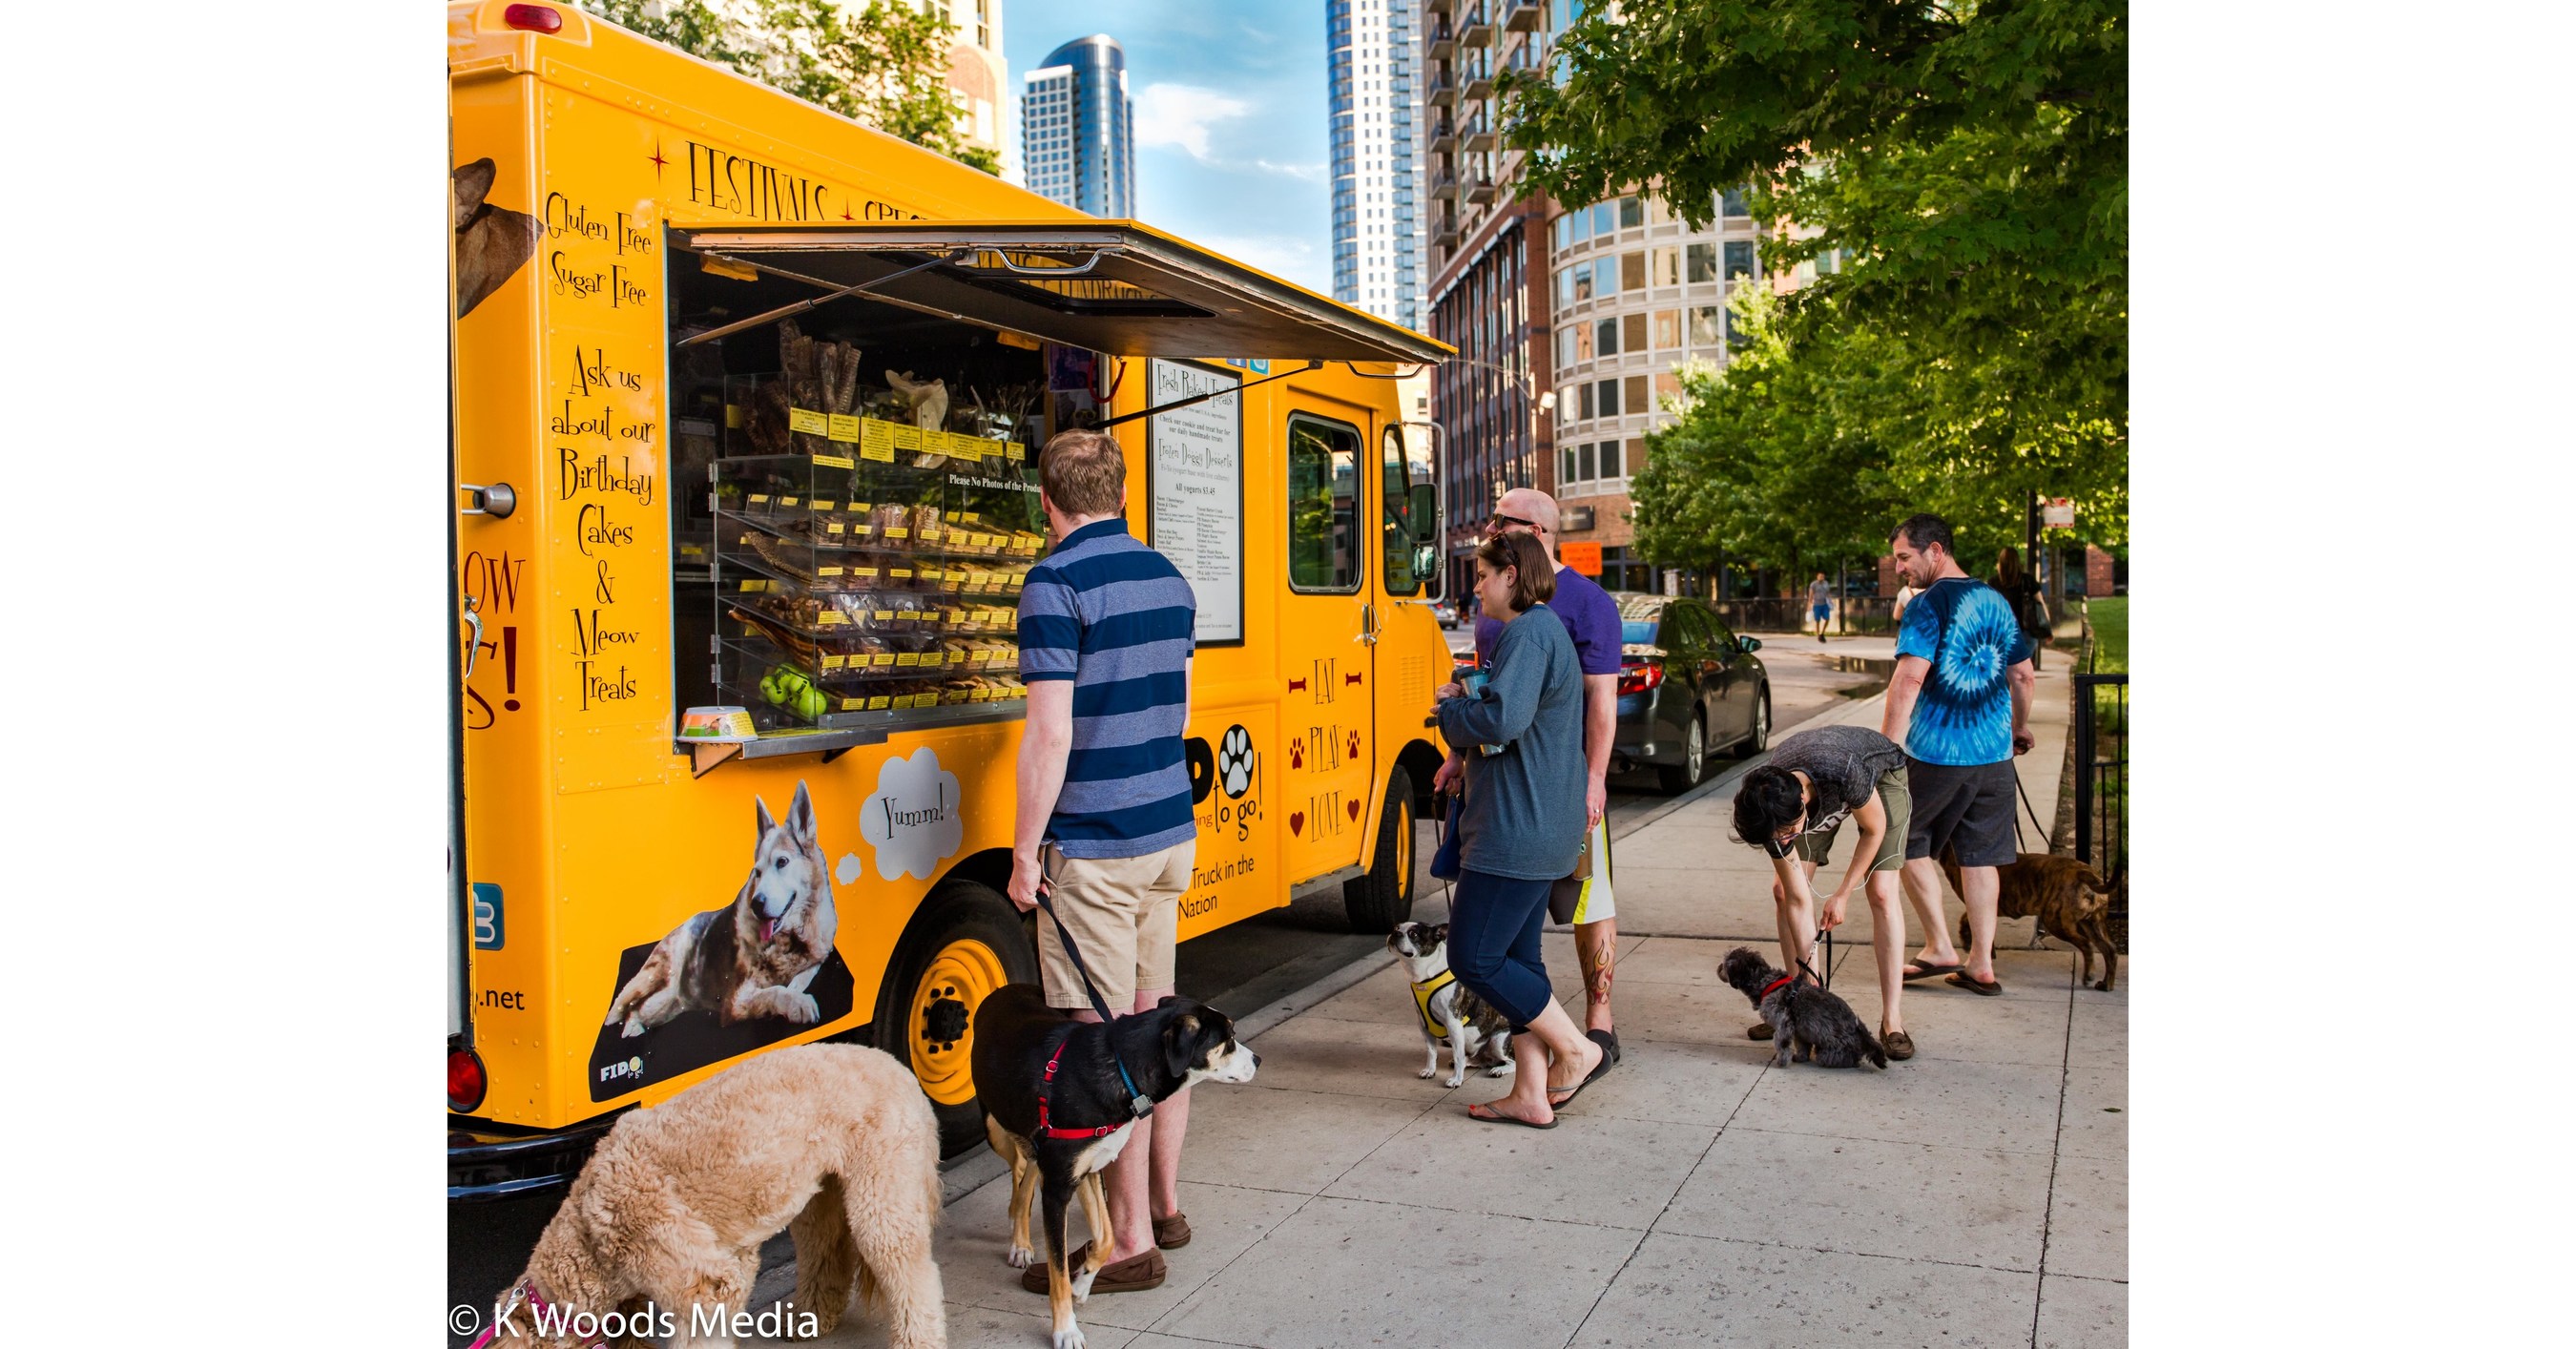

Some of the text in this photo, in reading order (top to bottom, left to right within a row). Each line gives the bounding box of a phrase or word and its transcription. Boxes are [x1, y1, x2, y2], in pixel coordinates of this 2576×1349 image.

[546, 192, 652, 256] Gluten Free
[551, 250, 646, 309] Sugar Free
[568, 344, 641, 397] Ask us
[551, 400, 655, 443] about our
[556, 447, 652, 506] Birthday
[949, 473, 970, 487] Please
[971, 476, 981, 488] No
[982, 478, 1004, 489] Photos
[1005, 480, 1012, 489] of
[1012, 481, 1022, 491] the
[577, 504, 633, 559] Cakes
[596, 559, 615, 604] &
[571, 608, 640, 658] Meow
[574, 660, 636, 712] Treats
[1313, 657, 1337, 705] EAT
[1309, 724, 1342, 774] PLAY
[881, 782, 944, 840] Yumm!
[1214, 752, 1262, 841] to go!
[1309, 790, 1343, 843] LOVE
[1192, 854, 1255, 891] Truck in the
[1178, 894, 1217, 922] Nation
[475, 988, 525, 1014] .net
